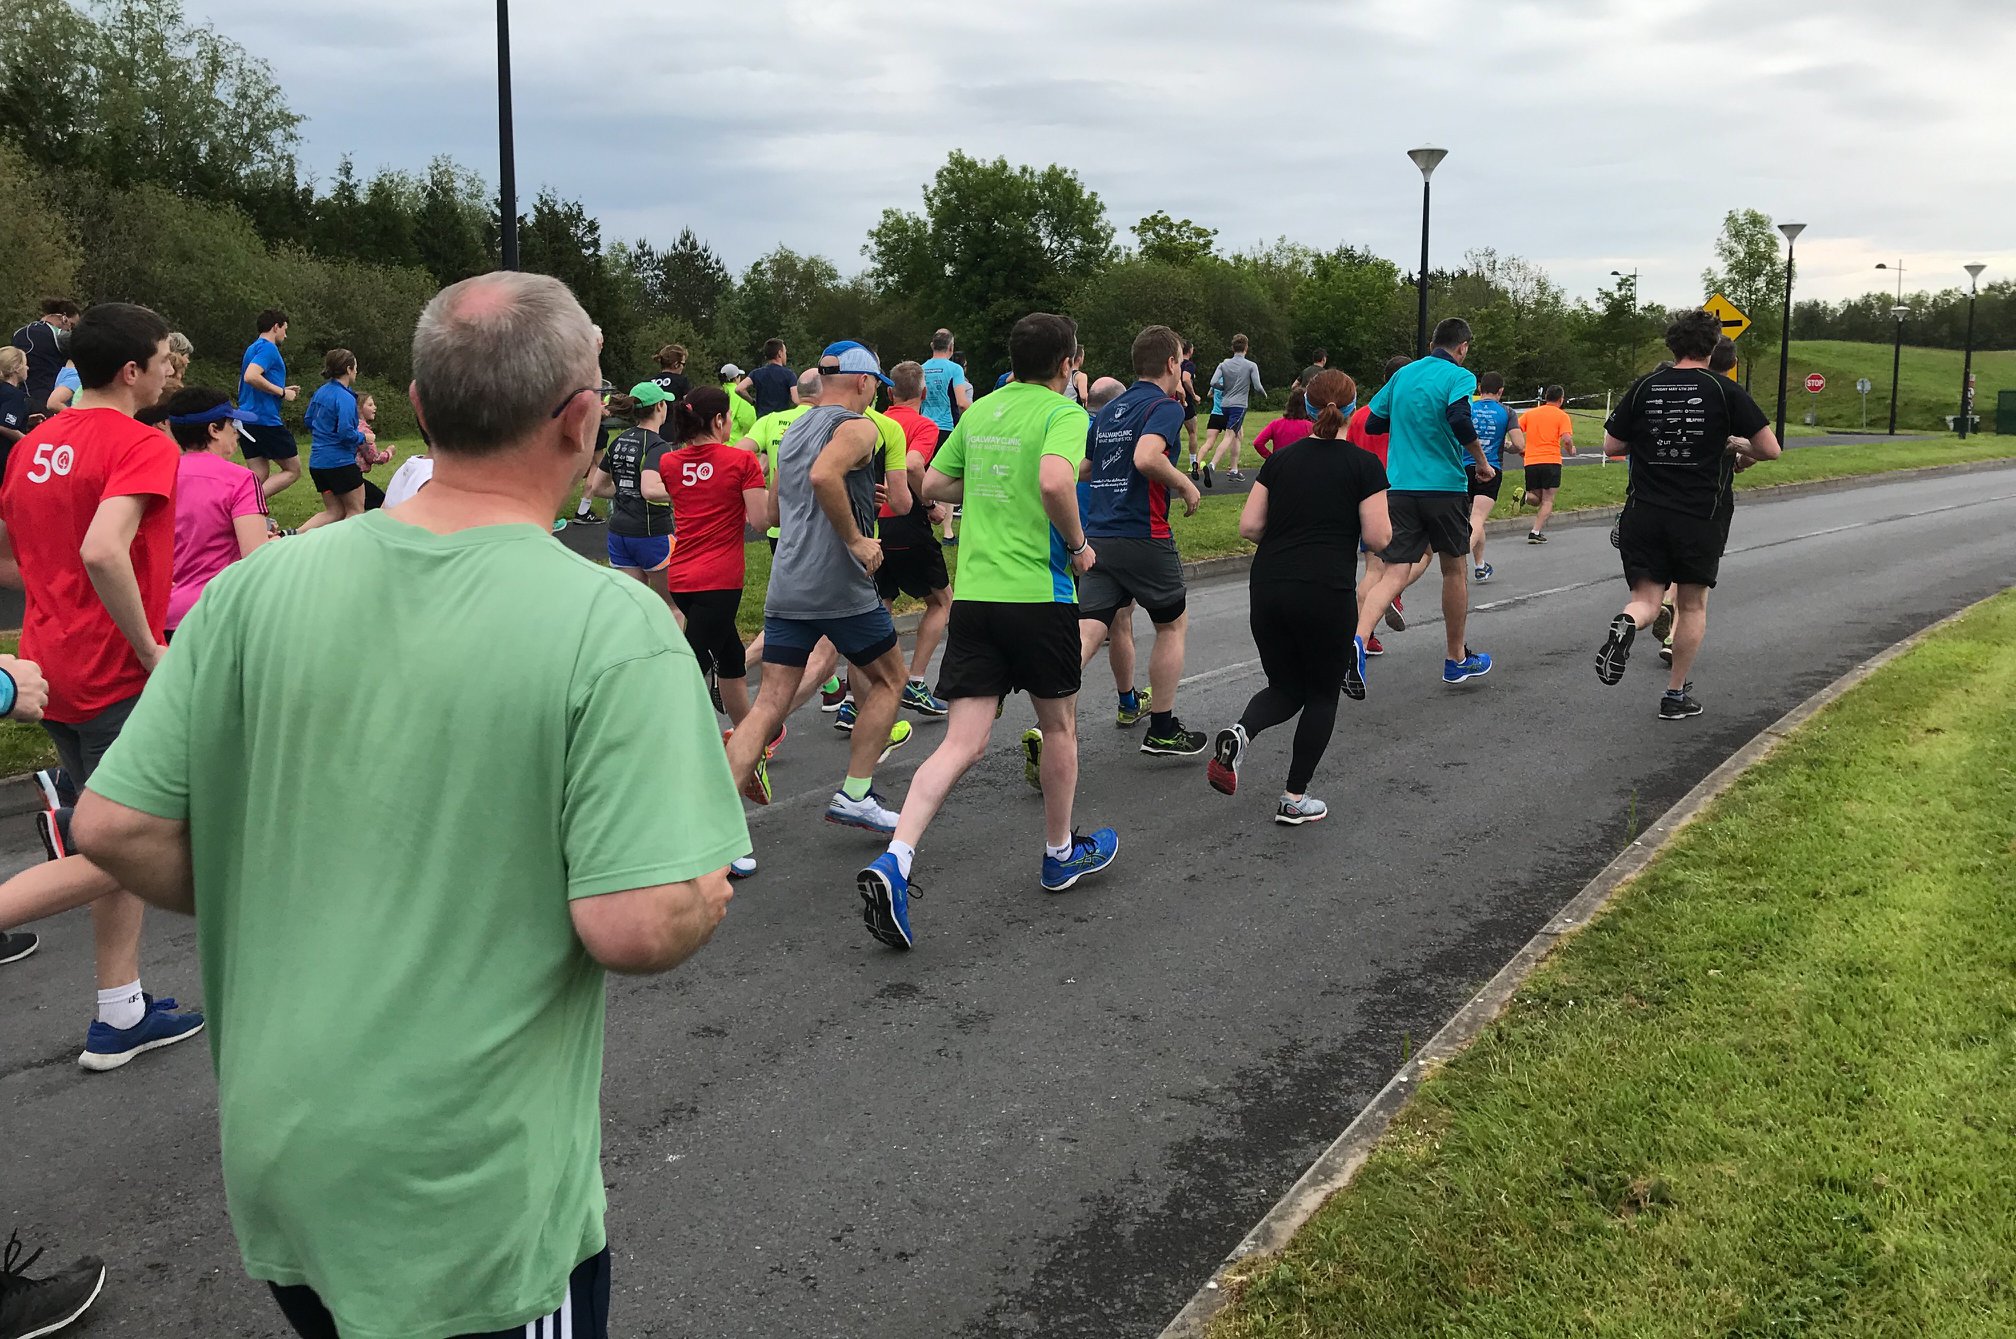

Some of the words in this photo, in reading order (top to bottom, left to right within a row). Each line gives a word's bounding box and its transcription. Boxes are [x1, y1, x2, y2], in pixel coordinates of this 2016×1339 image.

[1807, 379, 1823, 387] STOP
[27, 443, 74, 484] 50
[682, 462, 714, 487] 50
